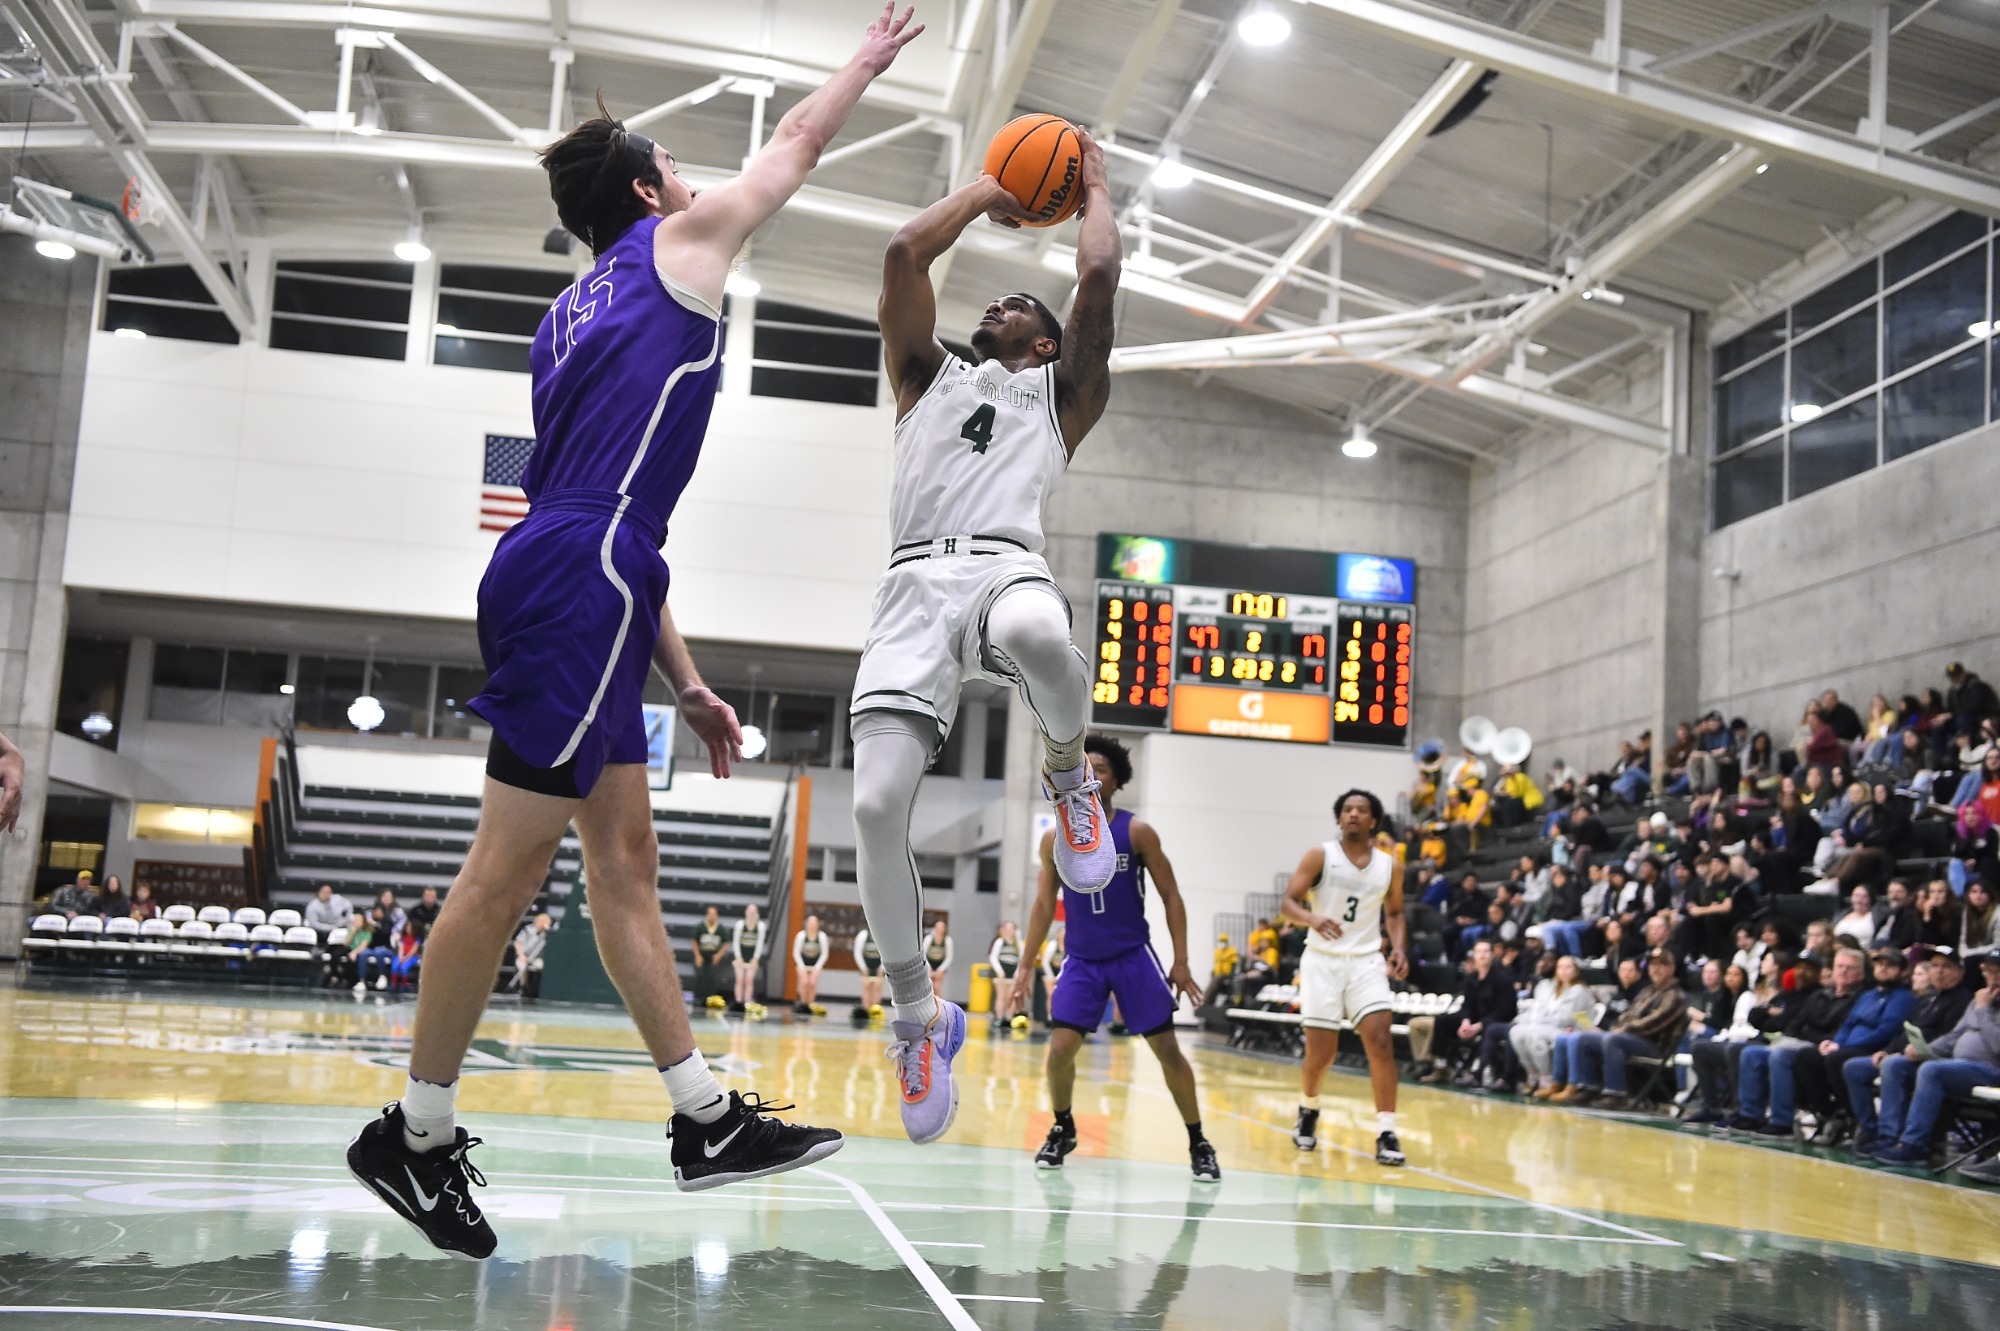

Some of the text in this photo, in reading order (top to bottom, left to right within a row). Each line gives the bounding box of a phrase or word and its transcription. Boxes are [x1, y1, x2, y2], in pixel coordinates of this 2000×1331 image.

[550, 256, 618, 368] 15
[960, 403, 996, 455] 4
[943, 538, 957, 554] H
[1109, 599, 1173, 623] 3 0 0
[1233, 592, 1287, 619] 17:01
[1107, 621, 1172, 644] 4 1 12
[1189, 626, 1219, 649] 47
[1246, 632, 1261, 652] 2
[1353, 620, 1411, 643] 1 1 2
[1138, 644, 1145, 662] 1
[1156, 645, 1171, 665] 0
[1303, 634, 1325, 658] 17
[1347, 640, 1410, 664] 5 0 2
[1193, 656, 1201, 674] 1
[1211, 656, 1224, 677] 3
[1259, 660, 1274, 681] 2
[1281, 662, 1296, 683] 2
[1315, 666, 1324, 683] 1
[1376, 664, 1385, 681] 1
[1396, 664, 1410, 684] 3
[1136, 666, 1145, 683] 1
[1157, 666, 1170, 686] 3
[1129, 685, 1144, 705] 2
[1240, 692, 1264, 719] G
[1376, 685, 1384, 702] 1
[1394, 686, 1408, 705] 5
[1369, 704, 1383, 724] 0
[1394, 706, 1408, 726] 0
[1343, 896, 1359, 922] 3
